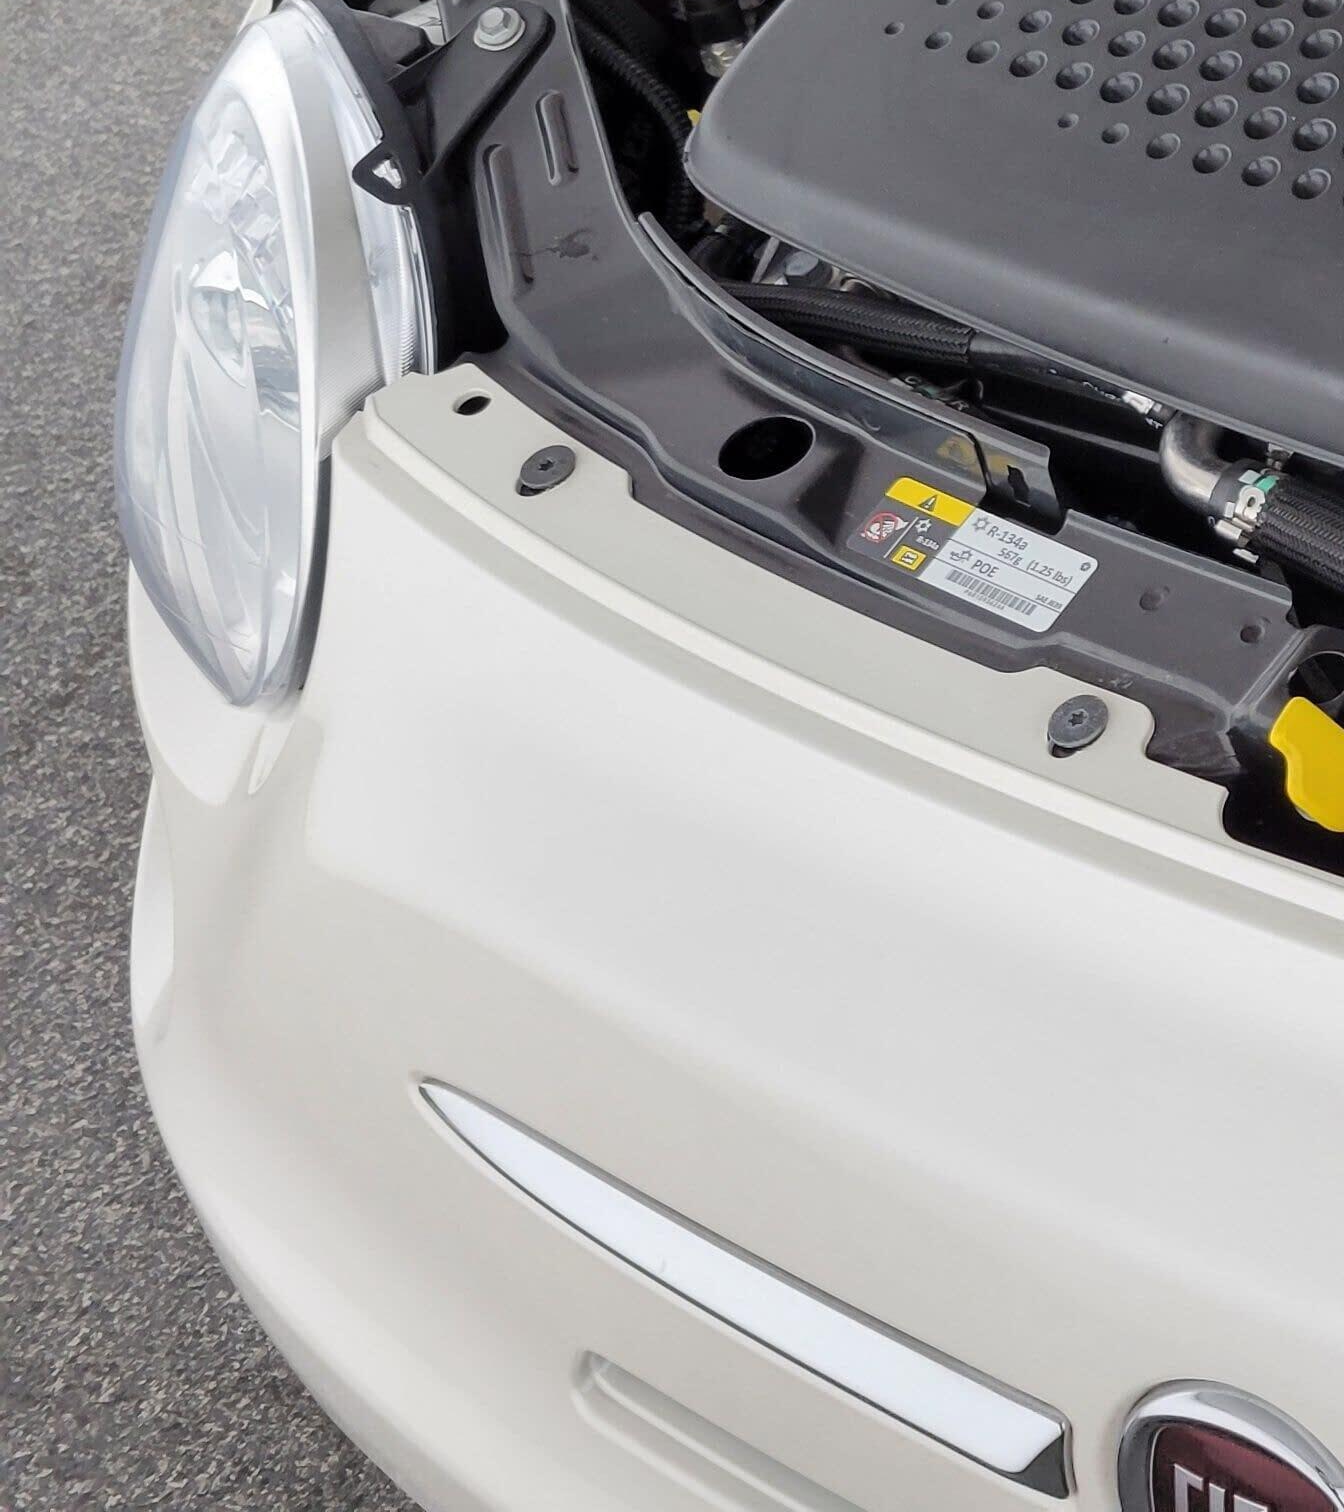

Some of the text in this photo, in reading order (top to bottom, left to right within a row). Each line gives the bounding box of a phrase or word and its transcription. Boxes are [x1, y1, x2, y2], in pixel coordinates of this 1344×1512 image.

[985, 525, 1029, 551] R-134a
[970, 559, 999, 579] POE
[1026, 559, 1053, 579] (1.25
[1052, 568, 1074, 587] lbs)
